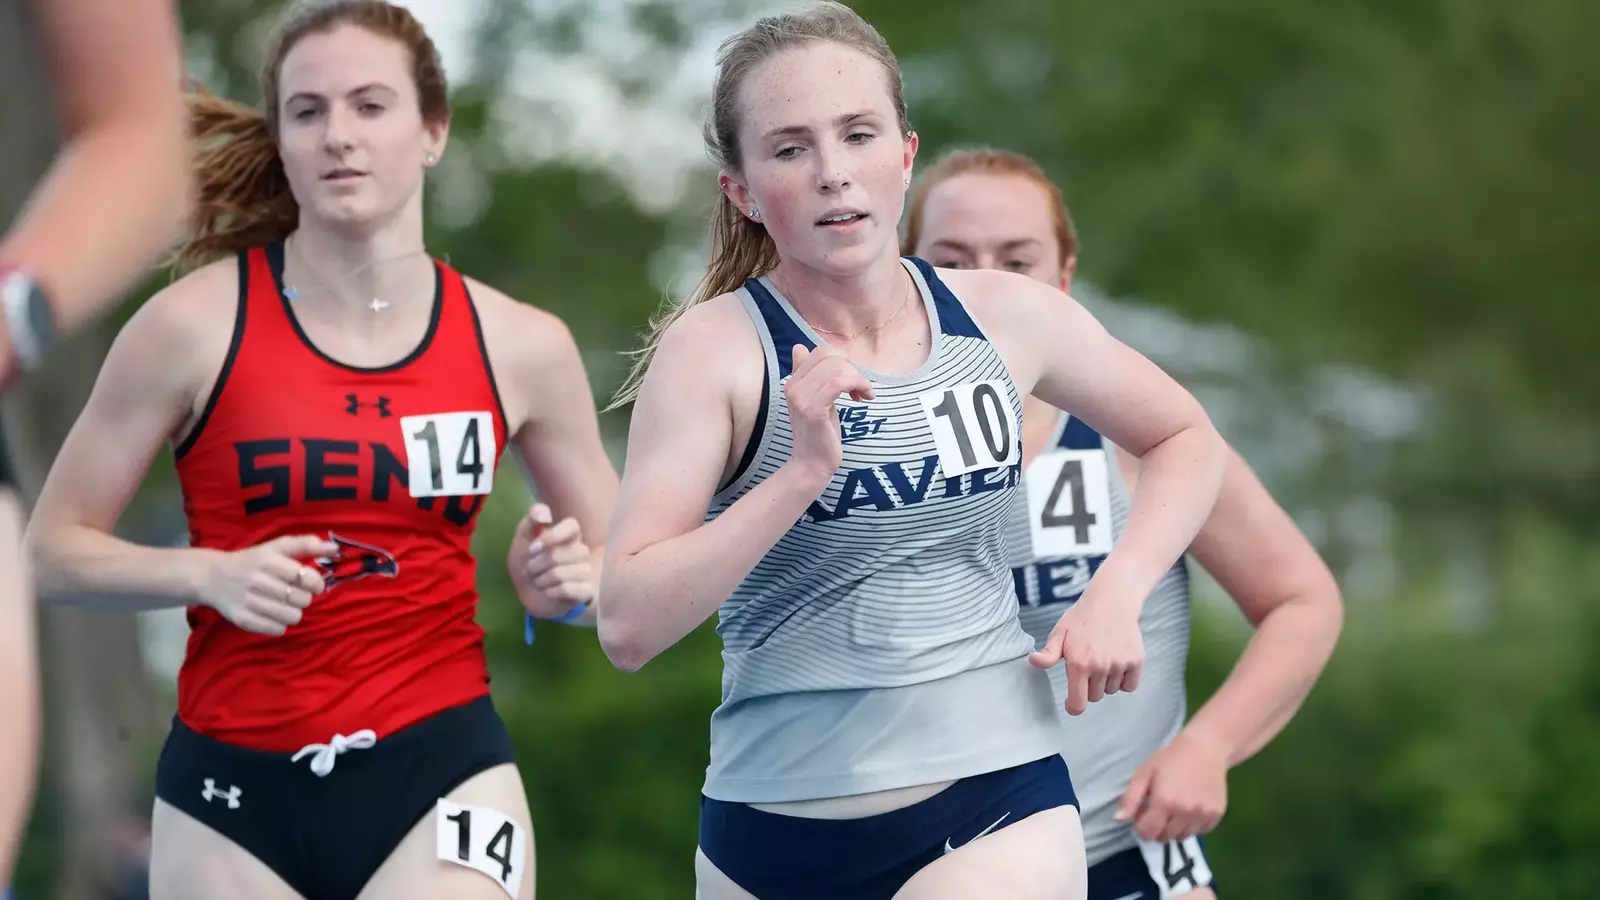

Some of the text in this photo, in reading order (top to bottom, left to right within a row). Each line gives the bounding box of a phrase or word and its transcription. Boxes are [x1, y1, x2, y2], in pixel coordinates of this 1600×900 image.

[838, 405, 869, 423] IG
[840, 418, 888, 439] ST
[931, 383, 1011, 469] 10
[412, 417, 485, 491] 14
[1041, 459, 1097, 545] 4
[446, 810, 514, 883] 14
[1163, 840, 1198, 888] 4
